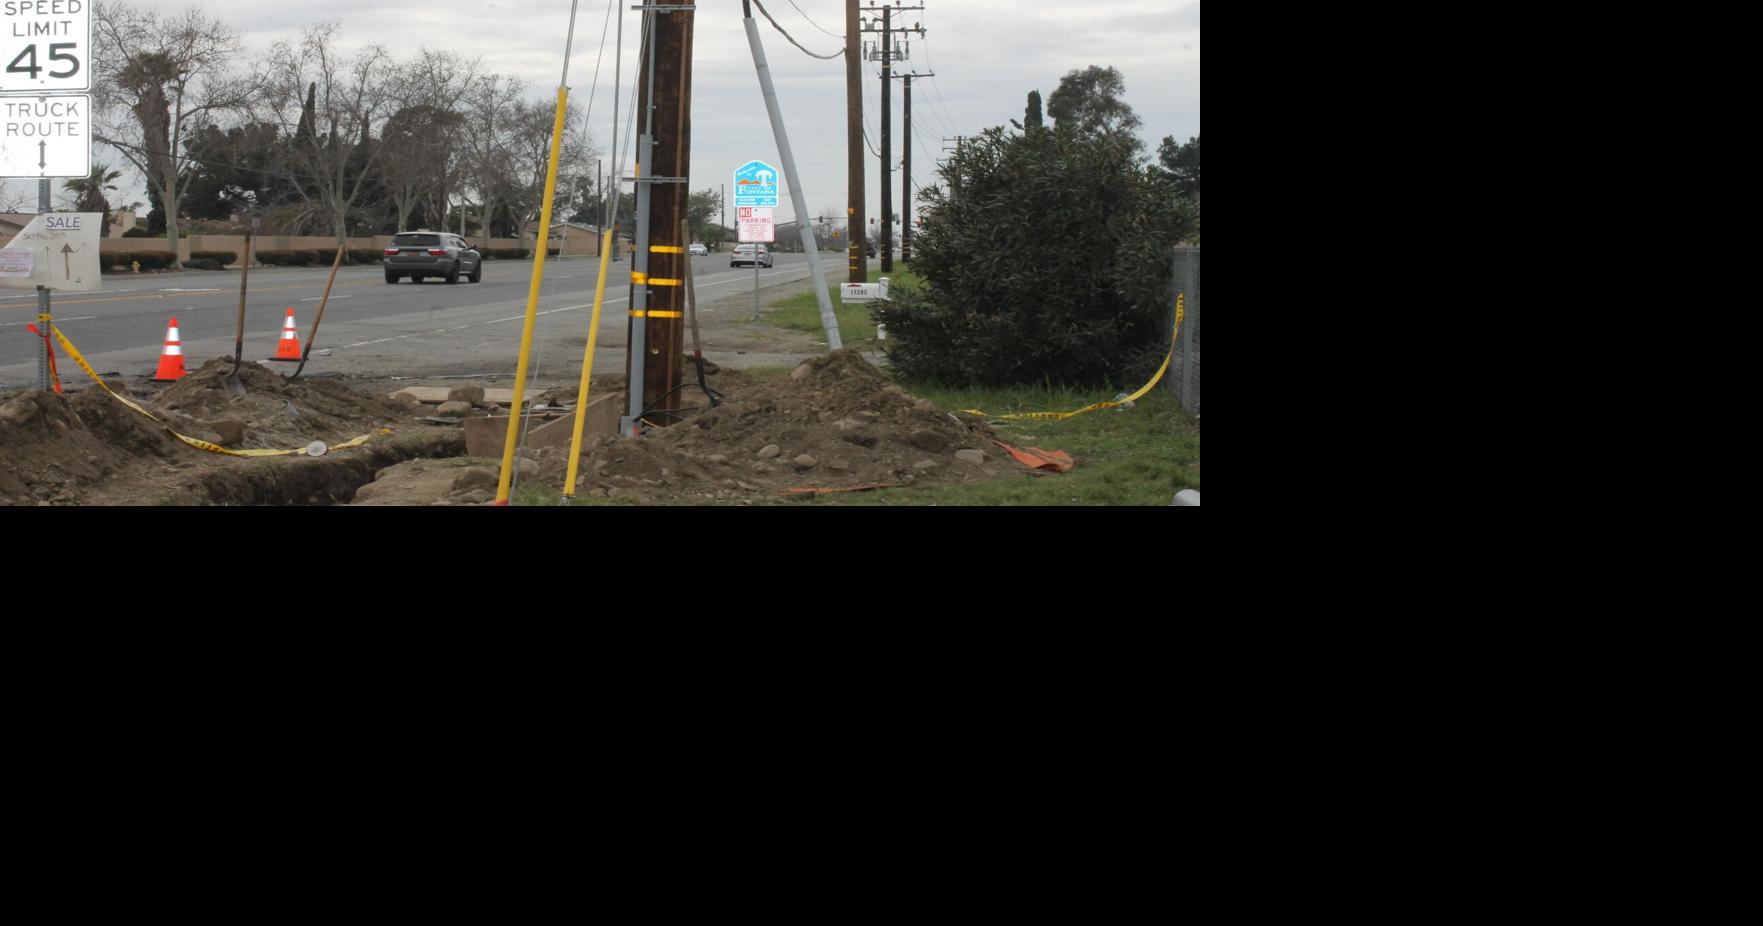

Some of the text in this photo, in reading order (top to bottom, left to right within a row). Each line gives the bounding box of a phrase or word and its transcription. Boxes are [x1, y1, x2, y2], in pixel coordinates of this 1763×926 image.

[5, 0, 82, 15] SPEED
[13, 21, 72, 37] LIMIT
[6, 42, 80, 79] 45
[5, 102, 79, 118] TRUCK
[6, 122, 80, 137] ROUTE
[740, 208, 751, 217] NO
[46, 217, 80, 228] SALE
